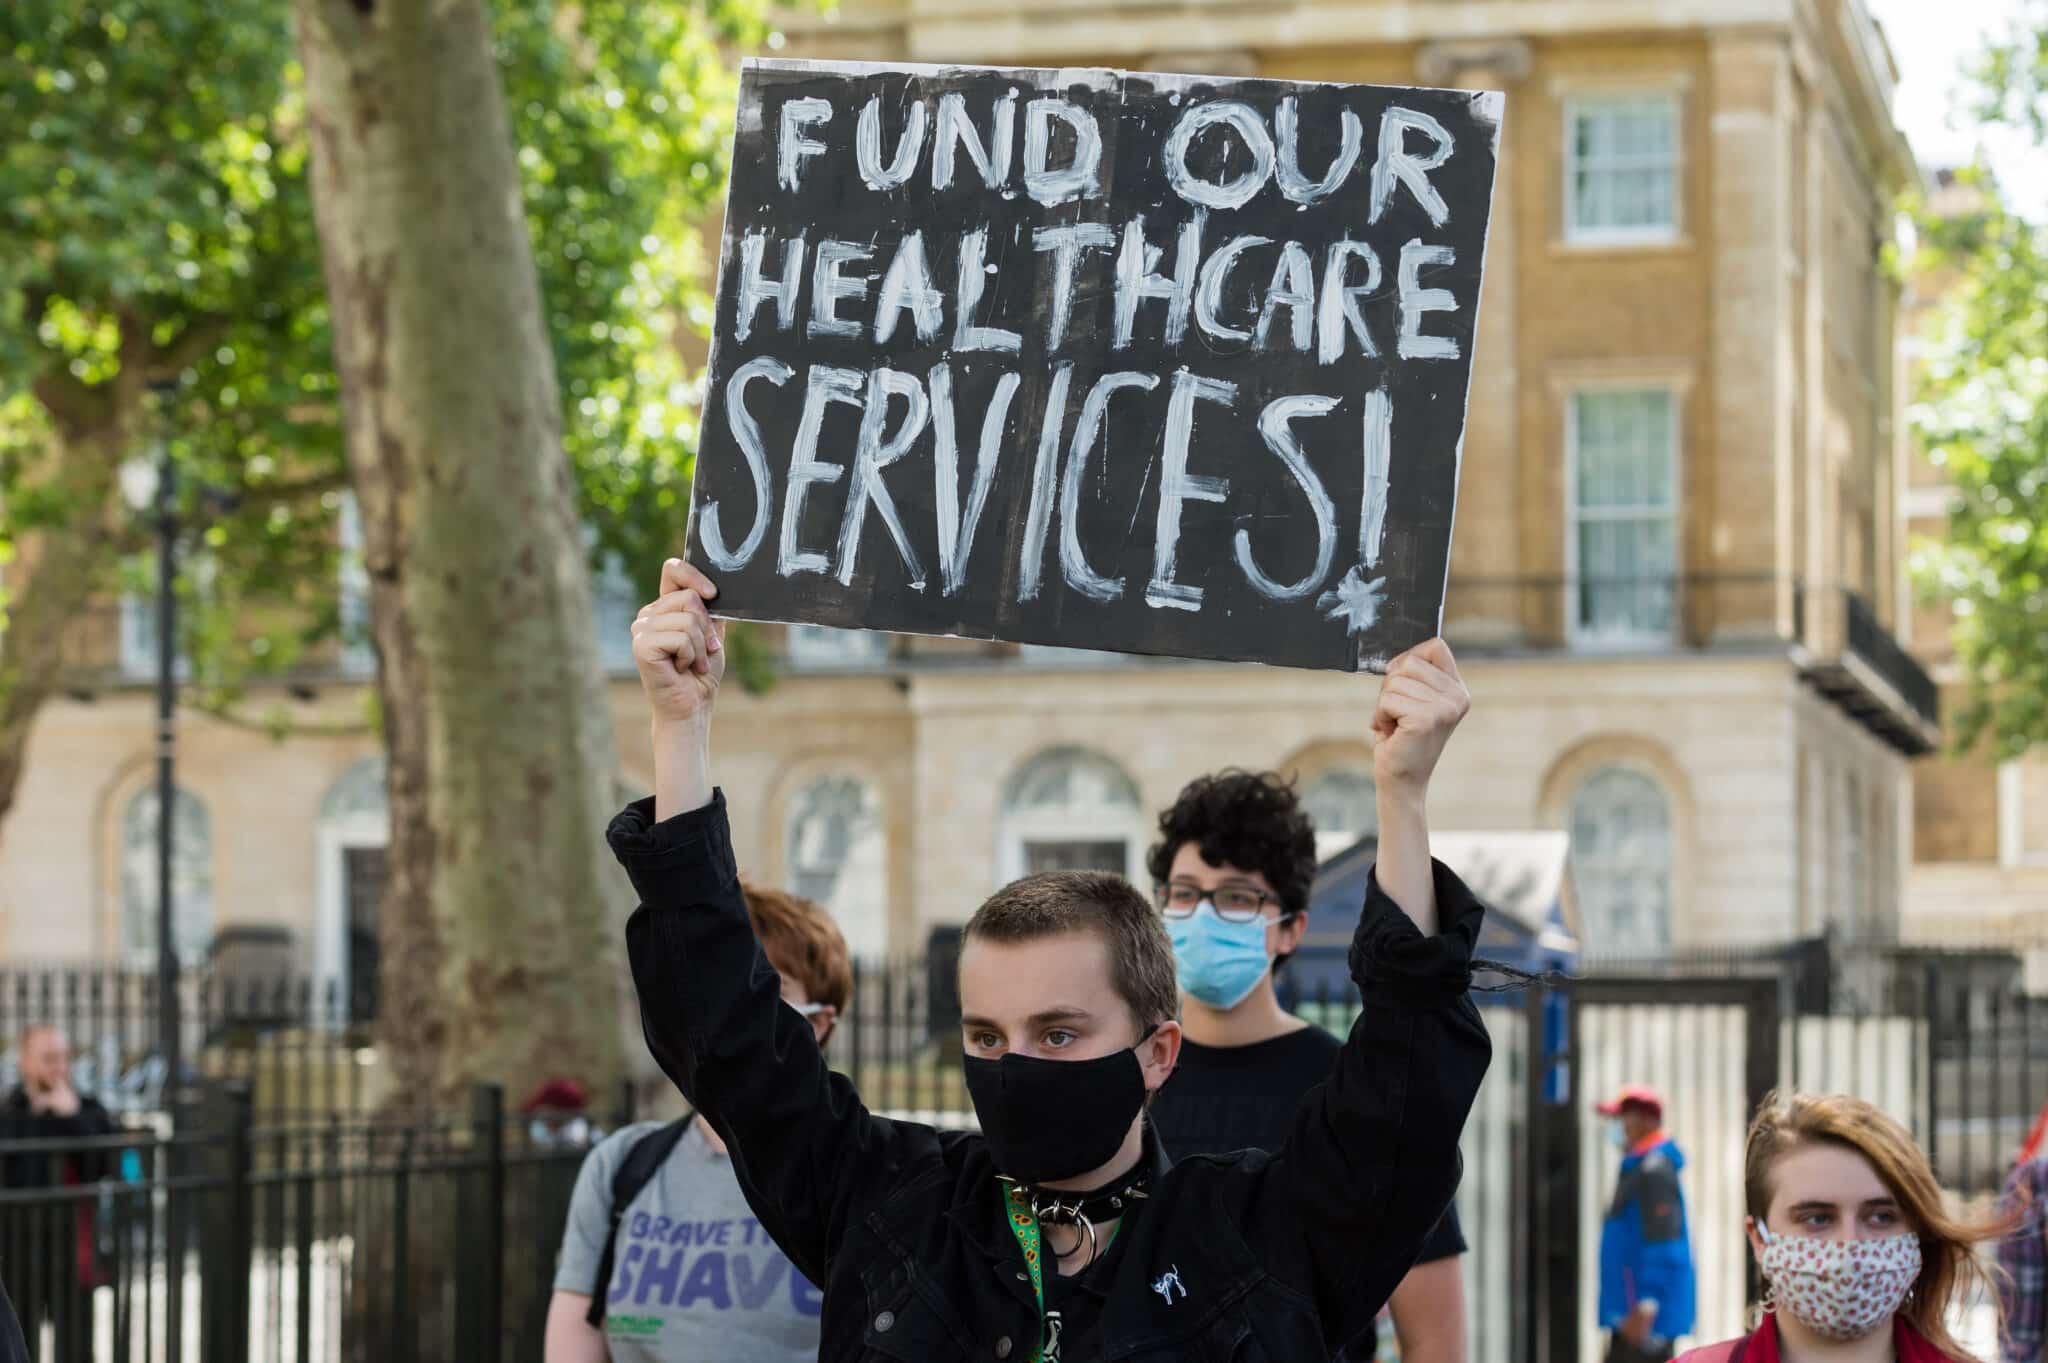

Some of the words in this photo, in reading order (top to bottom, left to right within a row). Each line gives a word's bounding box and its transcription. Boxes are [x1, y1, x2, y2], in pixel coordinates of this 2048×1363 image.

[777, 91, 1103, 206] FUND
[1163, 94, 1455, 226] OUR
[734, 213, 1460, 363] HEALTHCARE
[698, 355, 1392, 633] SERVICES!
[631, 1211, 731, 1247] BRAVE
